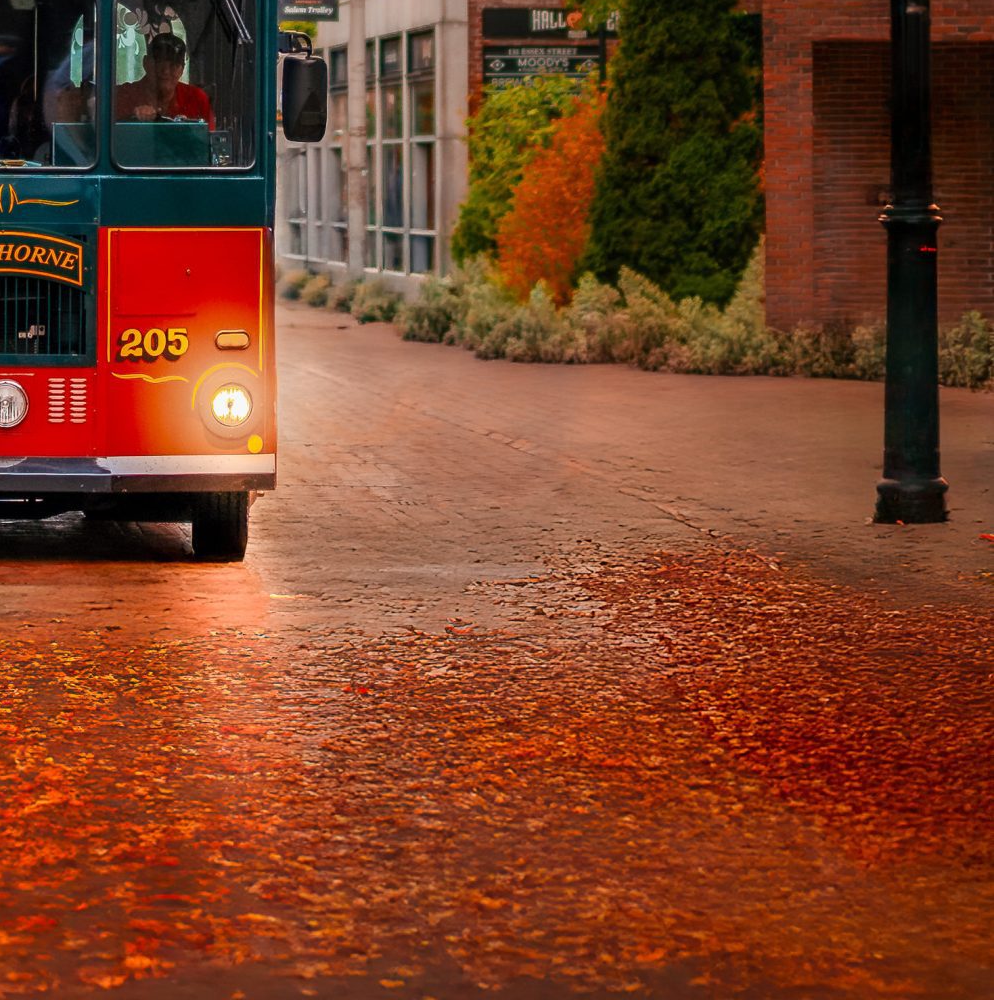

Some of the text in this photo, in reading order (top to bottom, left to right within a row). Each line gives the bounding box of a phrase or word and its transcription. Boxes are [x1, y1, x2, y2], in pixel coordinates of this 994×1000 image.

[284, 6, 334, 16] Salem Trolley
[521, 48, 544, 56] ESSEX
[546, 48, 578, 56] STREET
[517, 58, 570, 67] MOODY'S
[119, 327, 189, 357] 205
